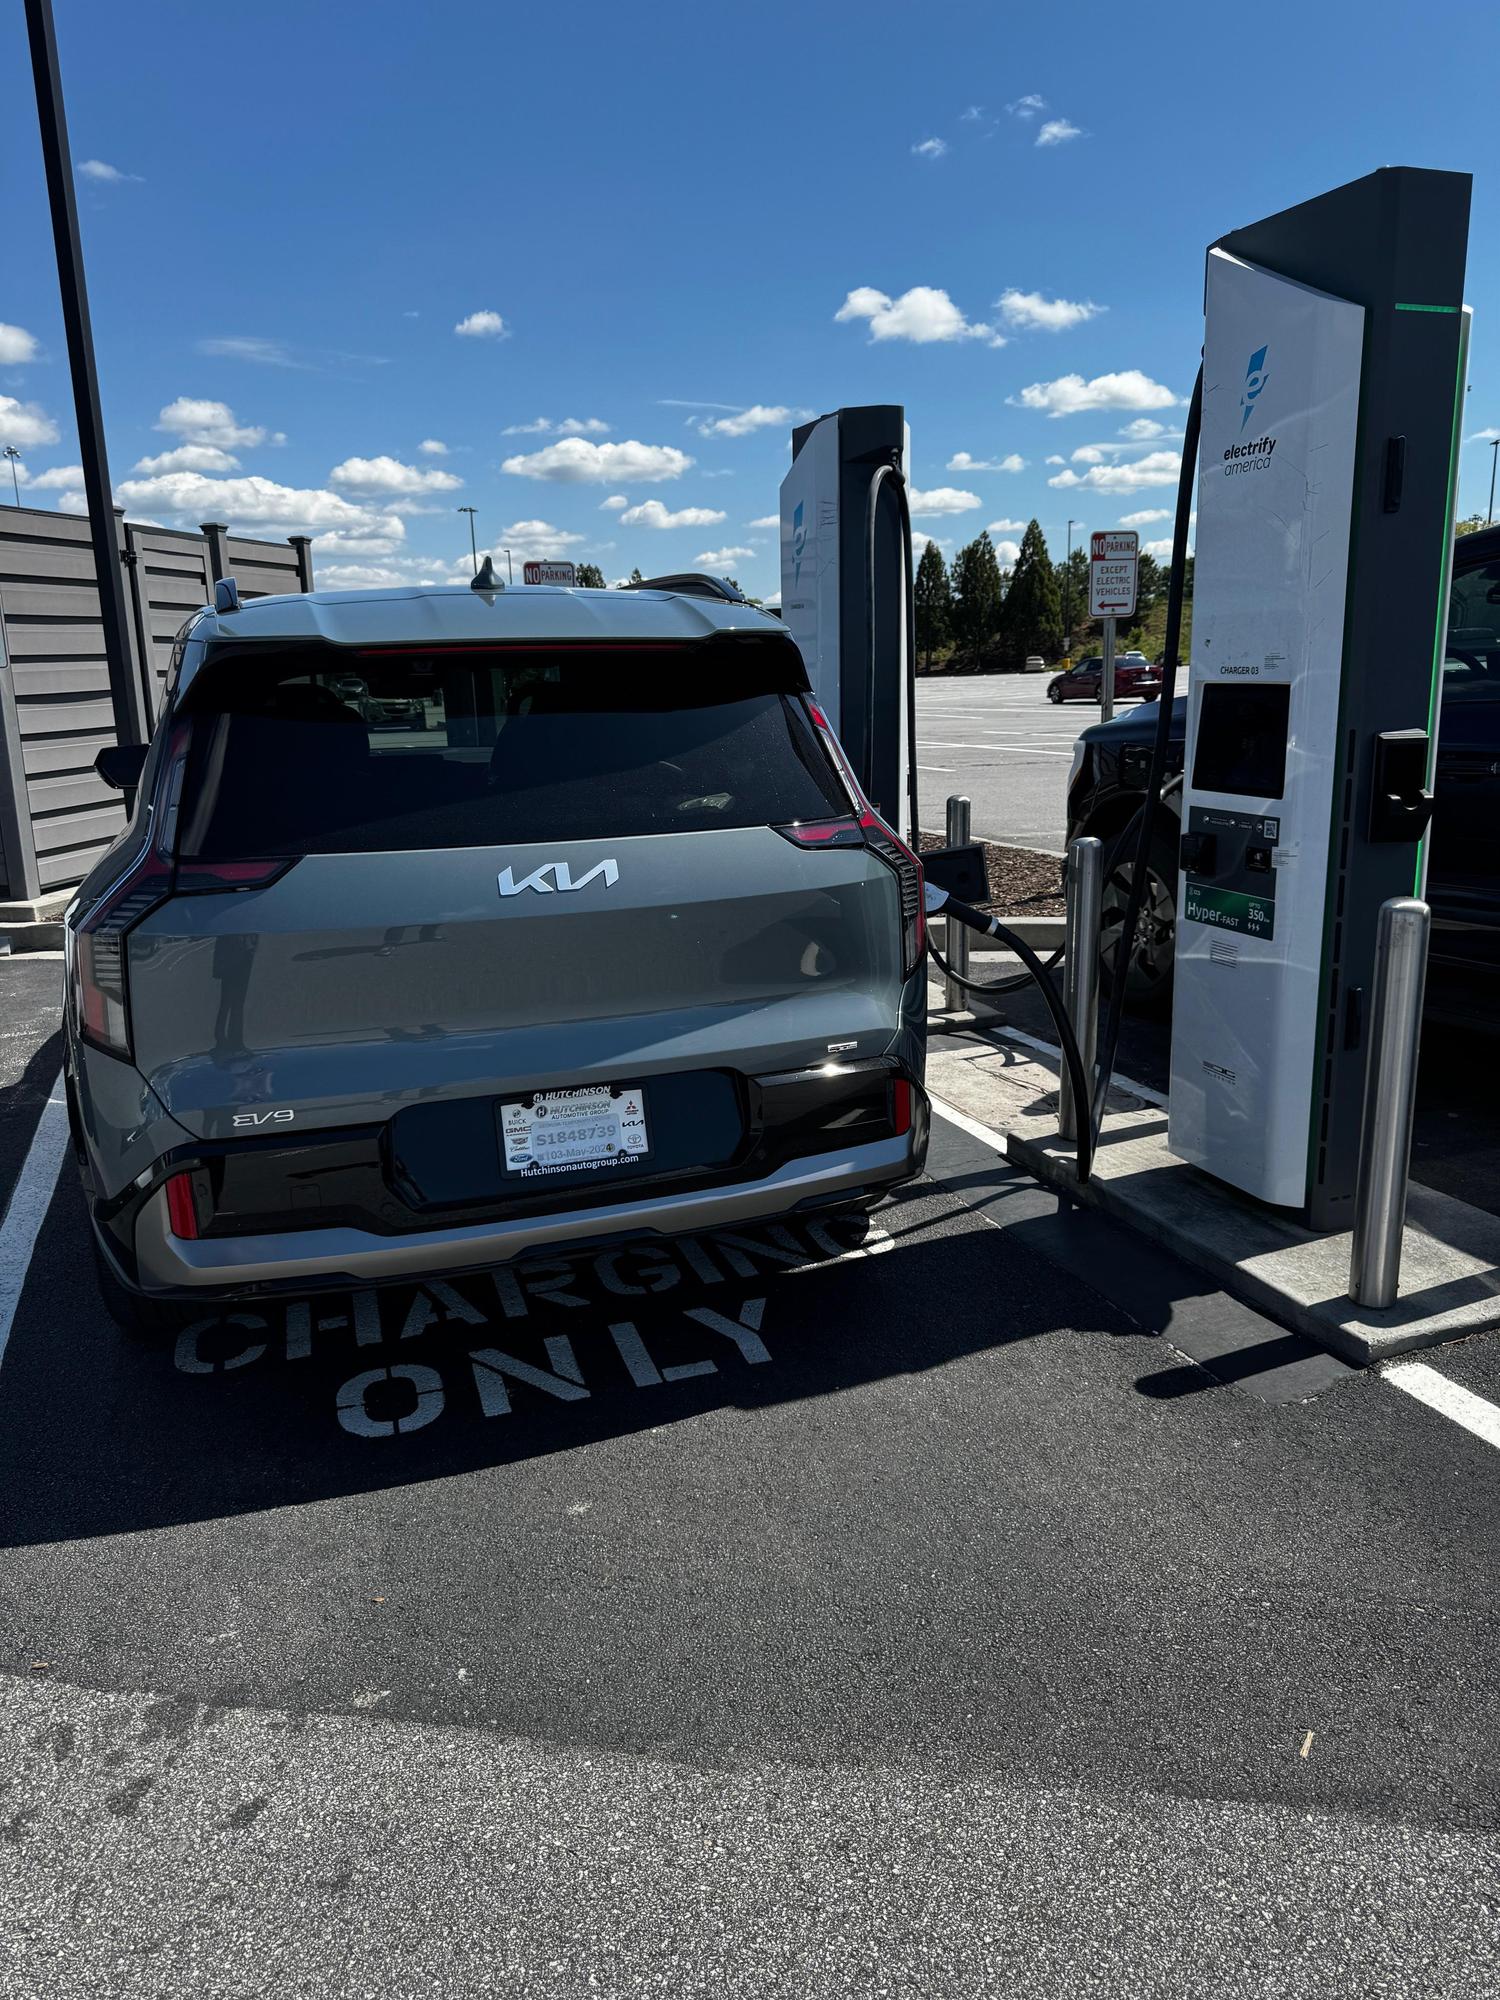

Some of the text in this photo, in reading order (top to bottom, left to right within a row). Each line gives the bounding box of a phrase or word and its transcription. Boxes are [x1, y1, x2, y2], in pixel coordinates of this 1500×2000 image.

[1224, 437, 1276, 460] electrify
[1224, 456, 1271, 476] america
[1093, 539, 1136, 556] NO PARKING
[525, 567, 572, 583] NO PARKING
[1100, 565, 1128, 574] EXCEPT
[1096, 576, 1131, 585] ELECTRIC
[1095, 587, 1131, 596] VEHICLES
[1220, 666, 1260, 675] CHARGER 03
[545, 1085, 611, 1101] HUTCHINSON
[550, 1100, 611, 1115] HUTCHINSON
[551, 1110, 588, 1120] AUTOMOTIVE
[232, 1109, 295, 1127] EV9
[508, 1118, 527, 1126] BUICK
[505, 1126, 532, 1134] GMC
[536, 1124, 617, 1146] S1848739
[520, 1155, 639, 1177] Hutchinsonautogroup.com
[174, 1215, 896, 1374] CHARGING
[336, 1298, 772, 1438] ONLY
